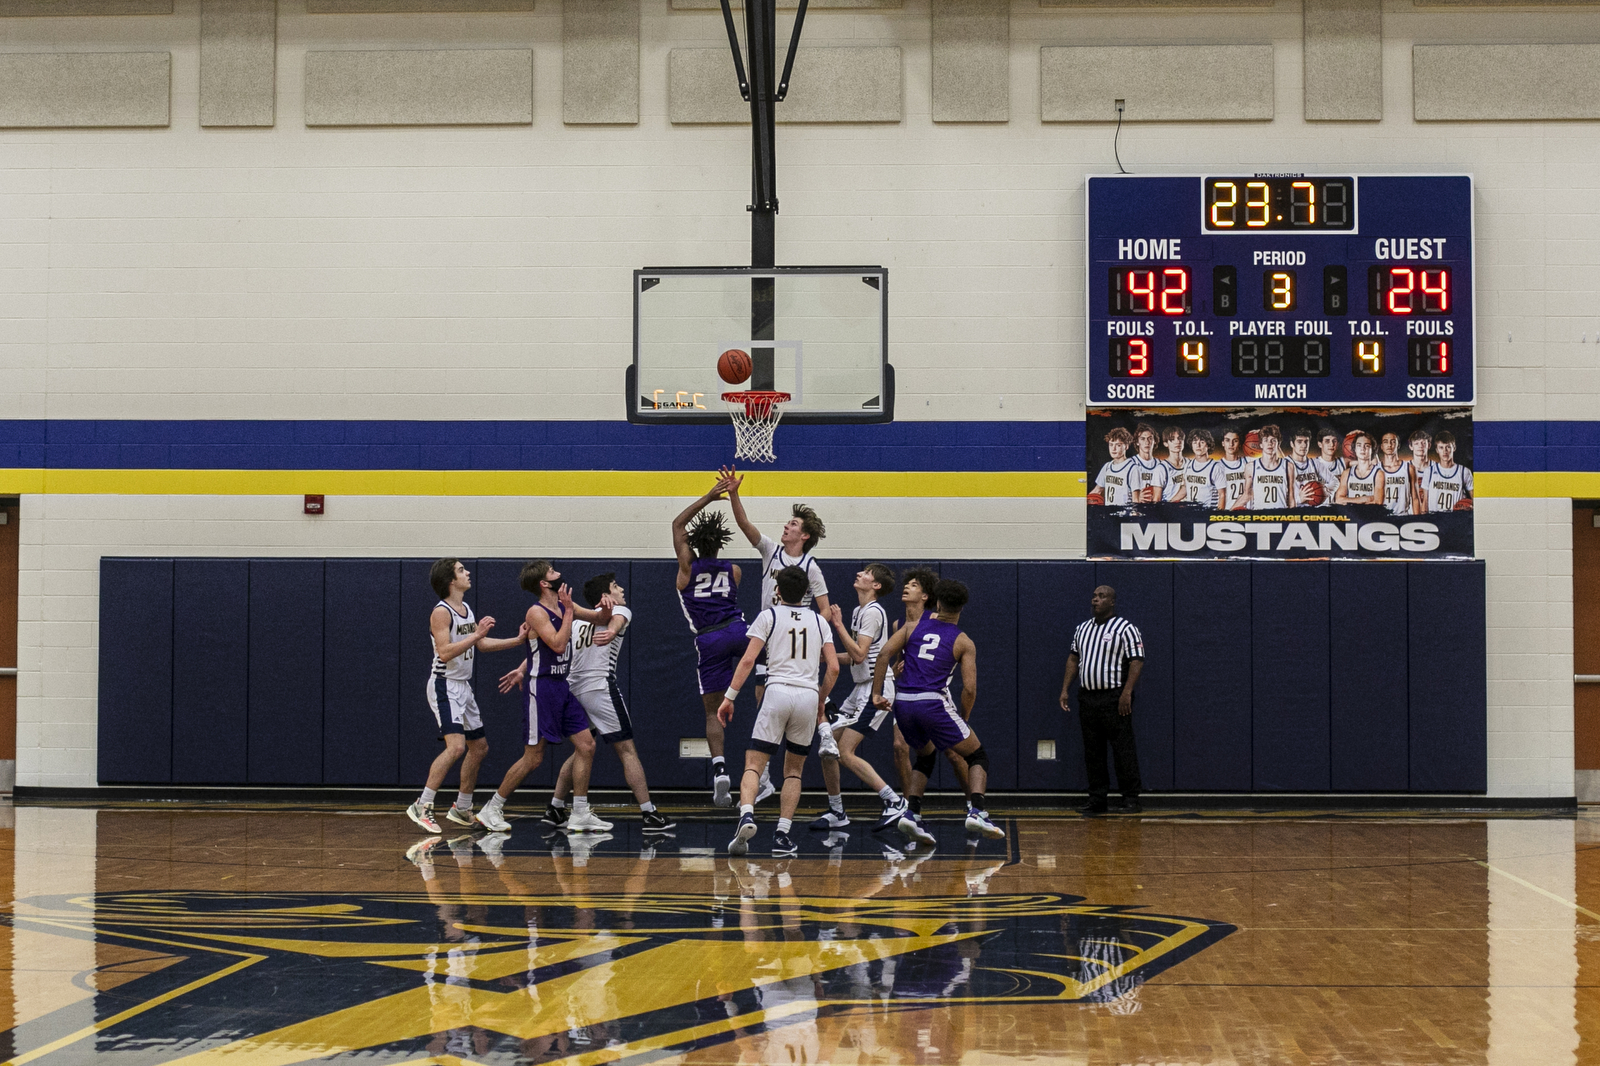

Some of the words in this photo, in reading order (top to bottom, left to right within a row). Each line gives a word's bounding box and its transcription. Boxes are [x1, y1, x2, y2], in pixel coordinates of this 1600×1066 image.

[1211, 182, 1315, 227] 23.7
[1118, 238, 1181, 260] HOME
[1375, 238, 1446, 260] GUEST
[1253, 251, 1306, 266] PERIOD
[1127, 268, 1187, 314] 42
[1272, 273, 1291, 309] 3
[1388, 268, 1447, 313] 24
[1221, 295, 1230, 308] B
[1332, 295, 1340, 308] B
[1107, 321, 1155, 336] FOULS
[1173, 321, 1214, 336] T.O.L.
[1229, 321, 1286, 336] PLAYER
[1295, 320, 1333, 335] FOUL
[1348, 320, 1389, 335] T.O.L.
[1406, 320, 1454, 335] FOULS
[1128, 340, 1148, 375] 3
[1183, 342, 1204, 372] 4
[1358, 341, 1380, 372] 4
[1440, 341, 1448, 373] 1
[1107, 384, 1155, 399] SCORE
[1255, 384, 1306, 399] MATCH
[1407, 384, 1455, 399] SCORE
[1257, 475, 1284, 484] MUSTANGS
[1433, 481, 1460, 491] MUSTANGS
[1190, 486, 1199, 501] 12
[1264, 486, 1278, 503] 20
[1385, 487, 1399, 503] 44
[1437, 492, 1453, 510] 40
[1120, 521, 1440, 552] MUSTANGS
[693, 571, 731, 598] 24
[575, 622, 596, 650] 30
[788, 627, 807, 660] 11
[917, 633, 941, 661] 2
